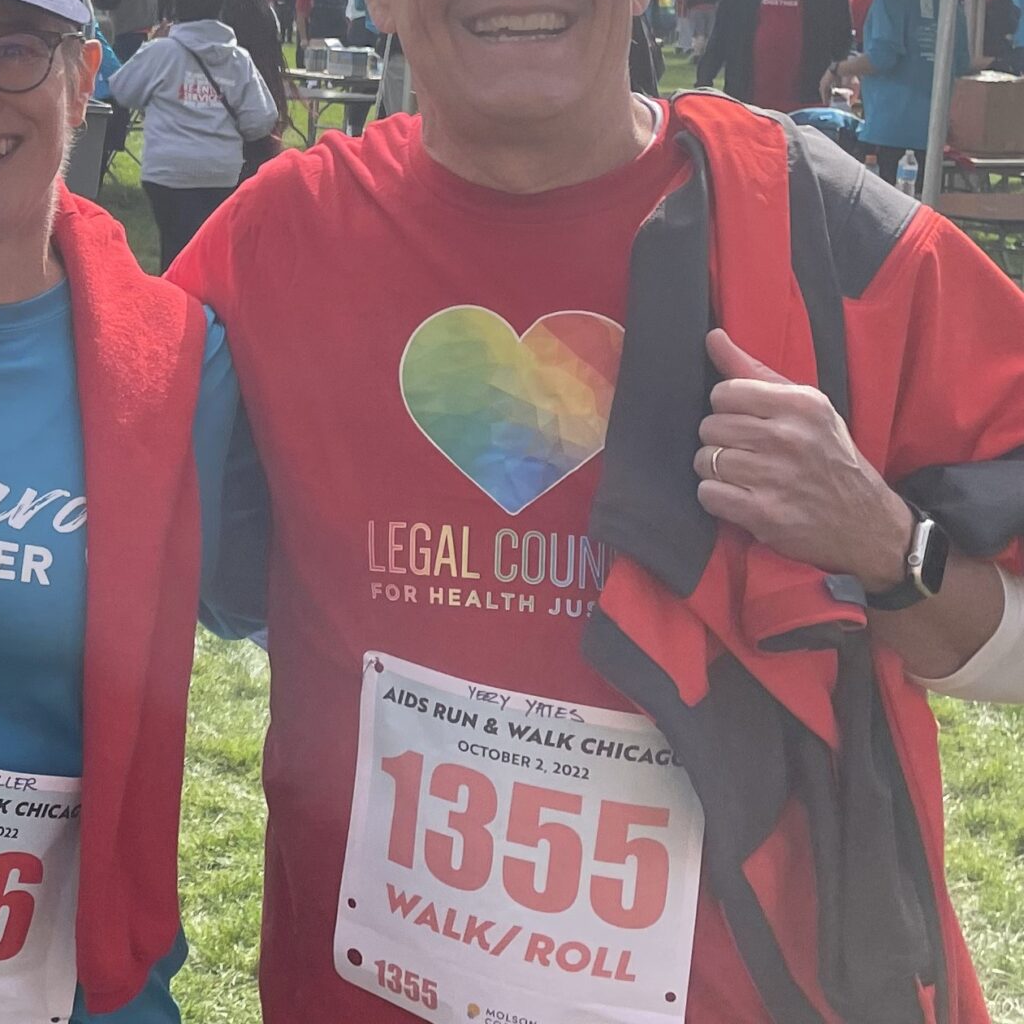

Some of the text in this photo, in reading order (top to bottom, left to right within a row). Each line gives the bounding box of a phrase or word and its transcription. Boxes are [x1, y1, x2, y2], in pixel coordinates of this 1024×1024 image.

[367, 520, 606, 592] LEGAL COUN
[370, 582, 418, 603] FOR
[429, 586, 536, 614] HEALTH
[382, 685, 430, 713] AIDS
[432, 702, 479, 730] RUN
[482, 717, 500, 736] &
[508, 722, 576, 752] WALK
[457, 740, 590, 781] OCTOBER 2, 2022
[14, 801, 82, 820] CHICAG
[381, 749, 671, 931] 1355
[374, 959, 439, 1012] 1355
